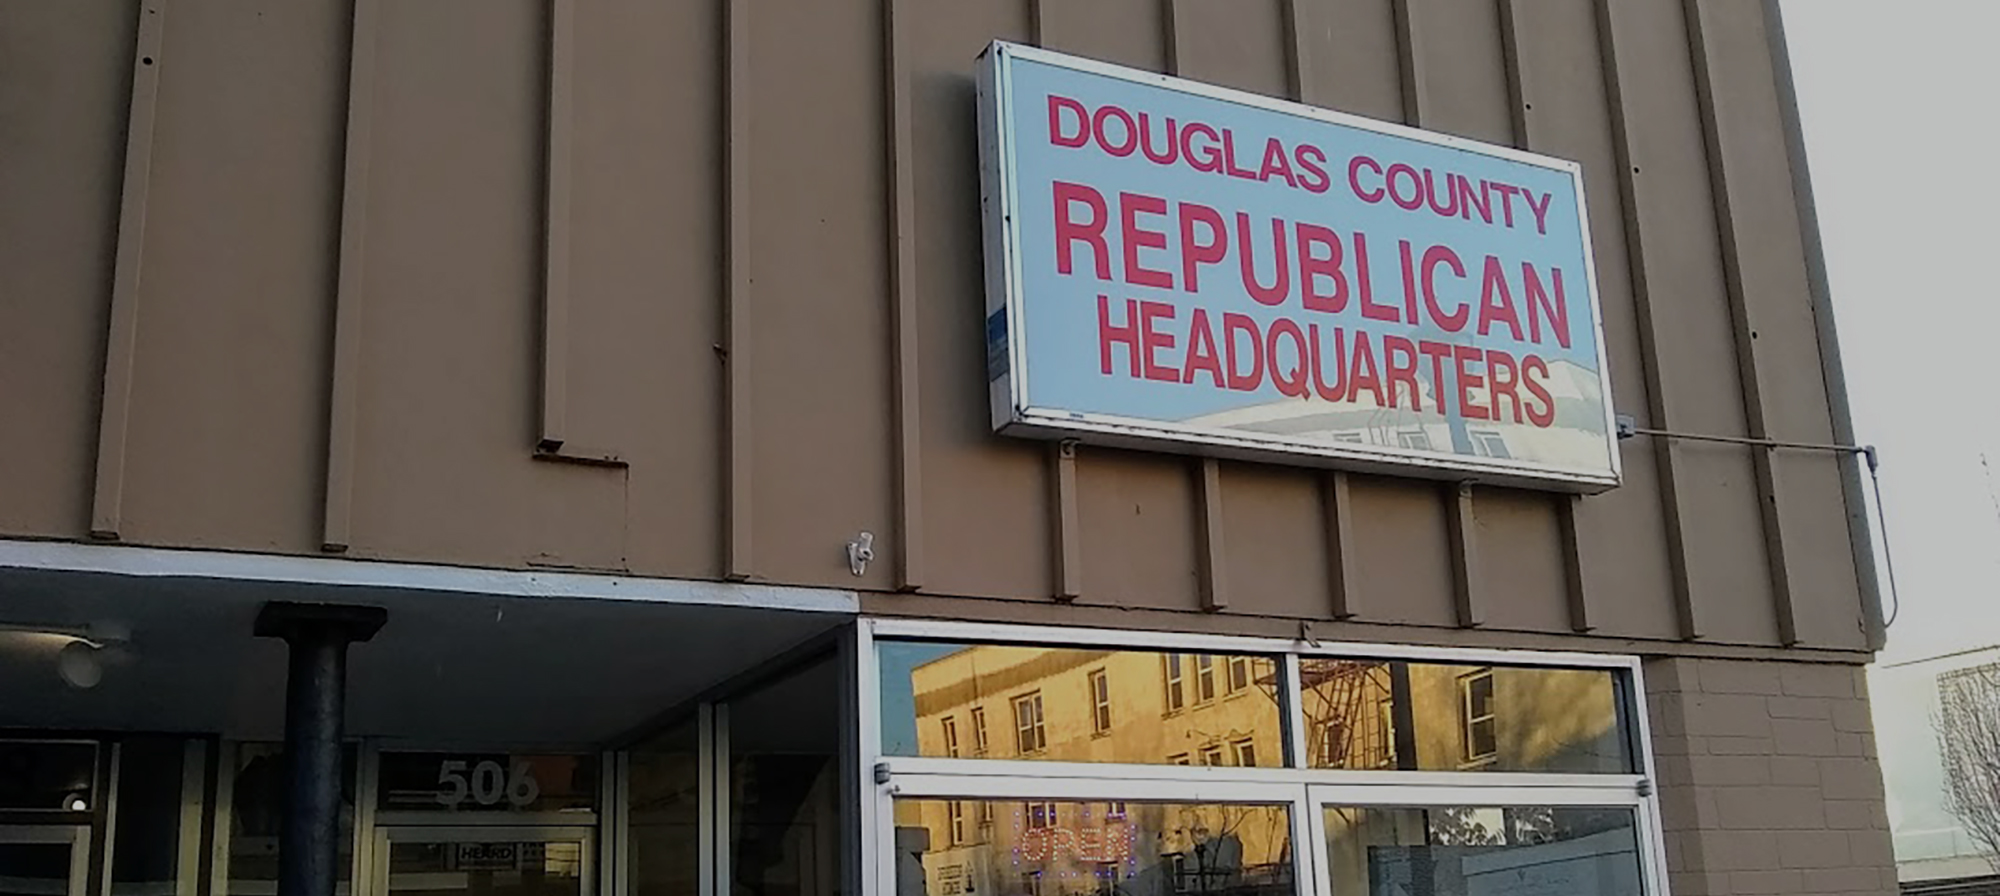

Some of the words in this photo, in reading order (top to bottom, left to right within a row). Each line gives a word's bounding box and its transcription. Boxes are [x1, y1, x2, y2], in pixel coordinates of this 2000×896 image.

[1048, 96, 1330, 194] DOUGLAS
[1349, 156, 1552, 236] COUNTY
[1053, 181, 1571, 349] REPUBLICAN
[1097, 294, 1555, 428] HEADQUARTERS
[436, 760, 540, 806] 506
[1021, 828, 1128, 861] OPEN
